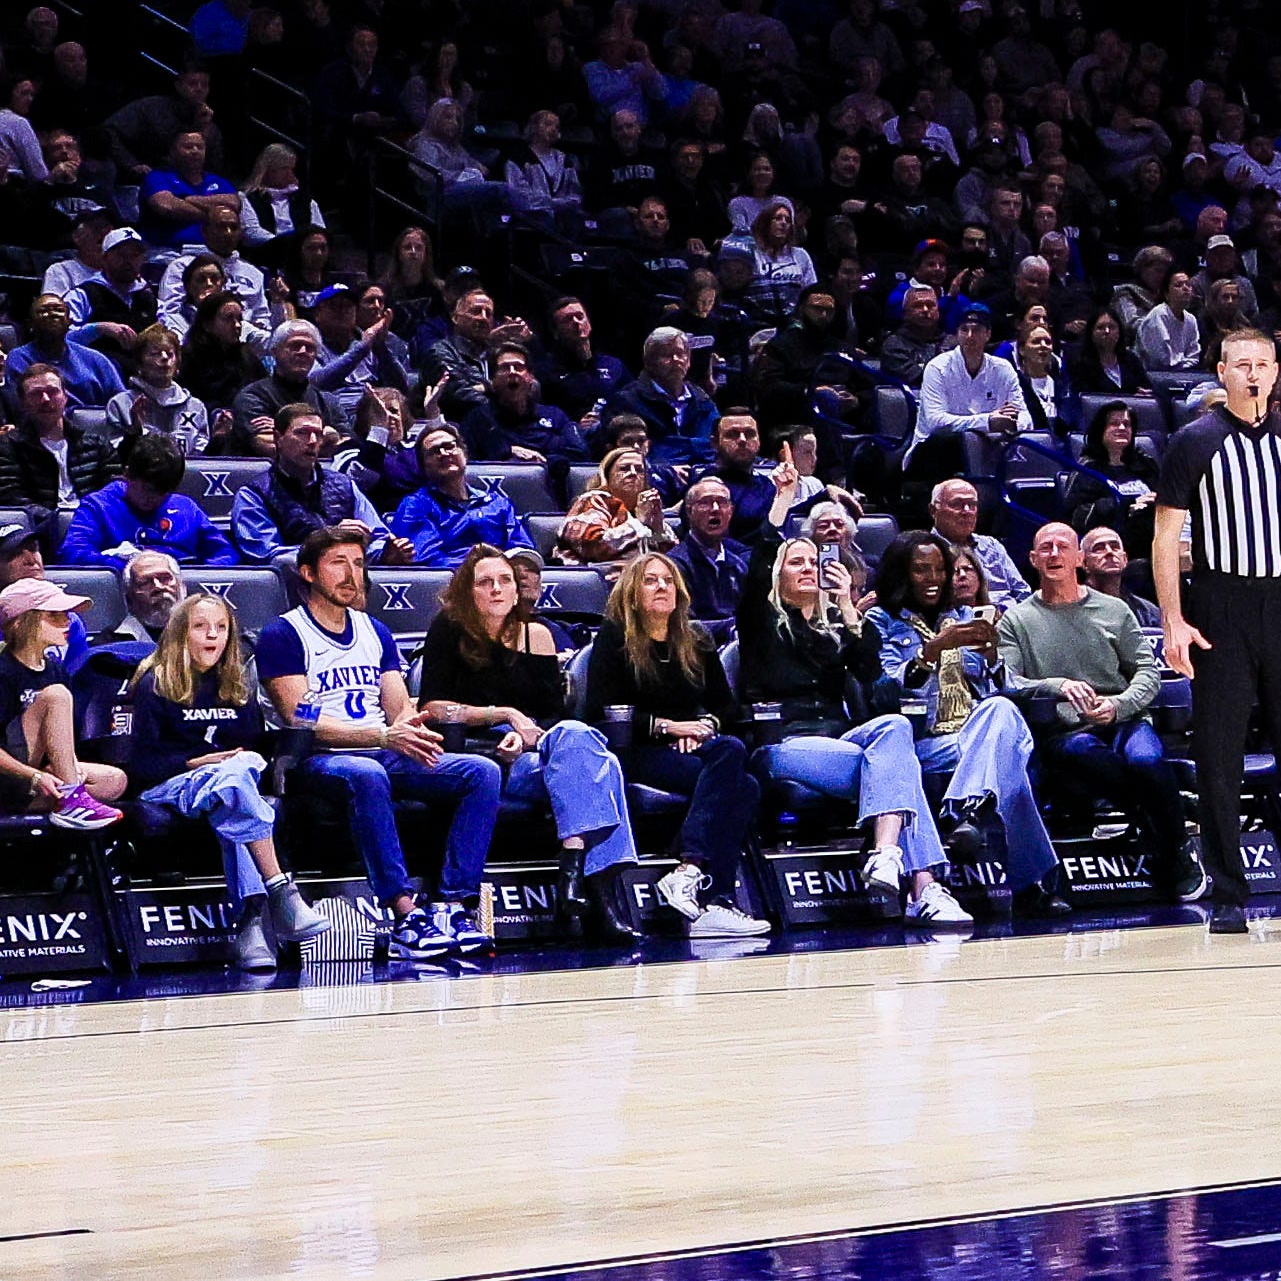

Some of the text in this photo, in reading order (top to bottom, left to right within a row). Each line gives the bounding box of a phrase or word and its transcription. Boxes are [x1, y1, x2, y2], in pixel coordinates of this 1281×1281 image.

[181, 708, 238, 721] XAVIER
[1063, 853, 1152, 881] FENIX
[784, 869, 860, 897] FENI
[139, 903, 236, 935] FENI
[28, 944, 86, 958] MATERIALS
